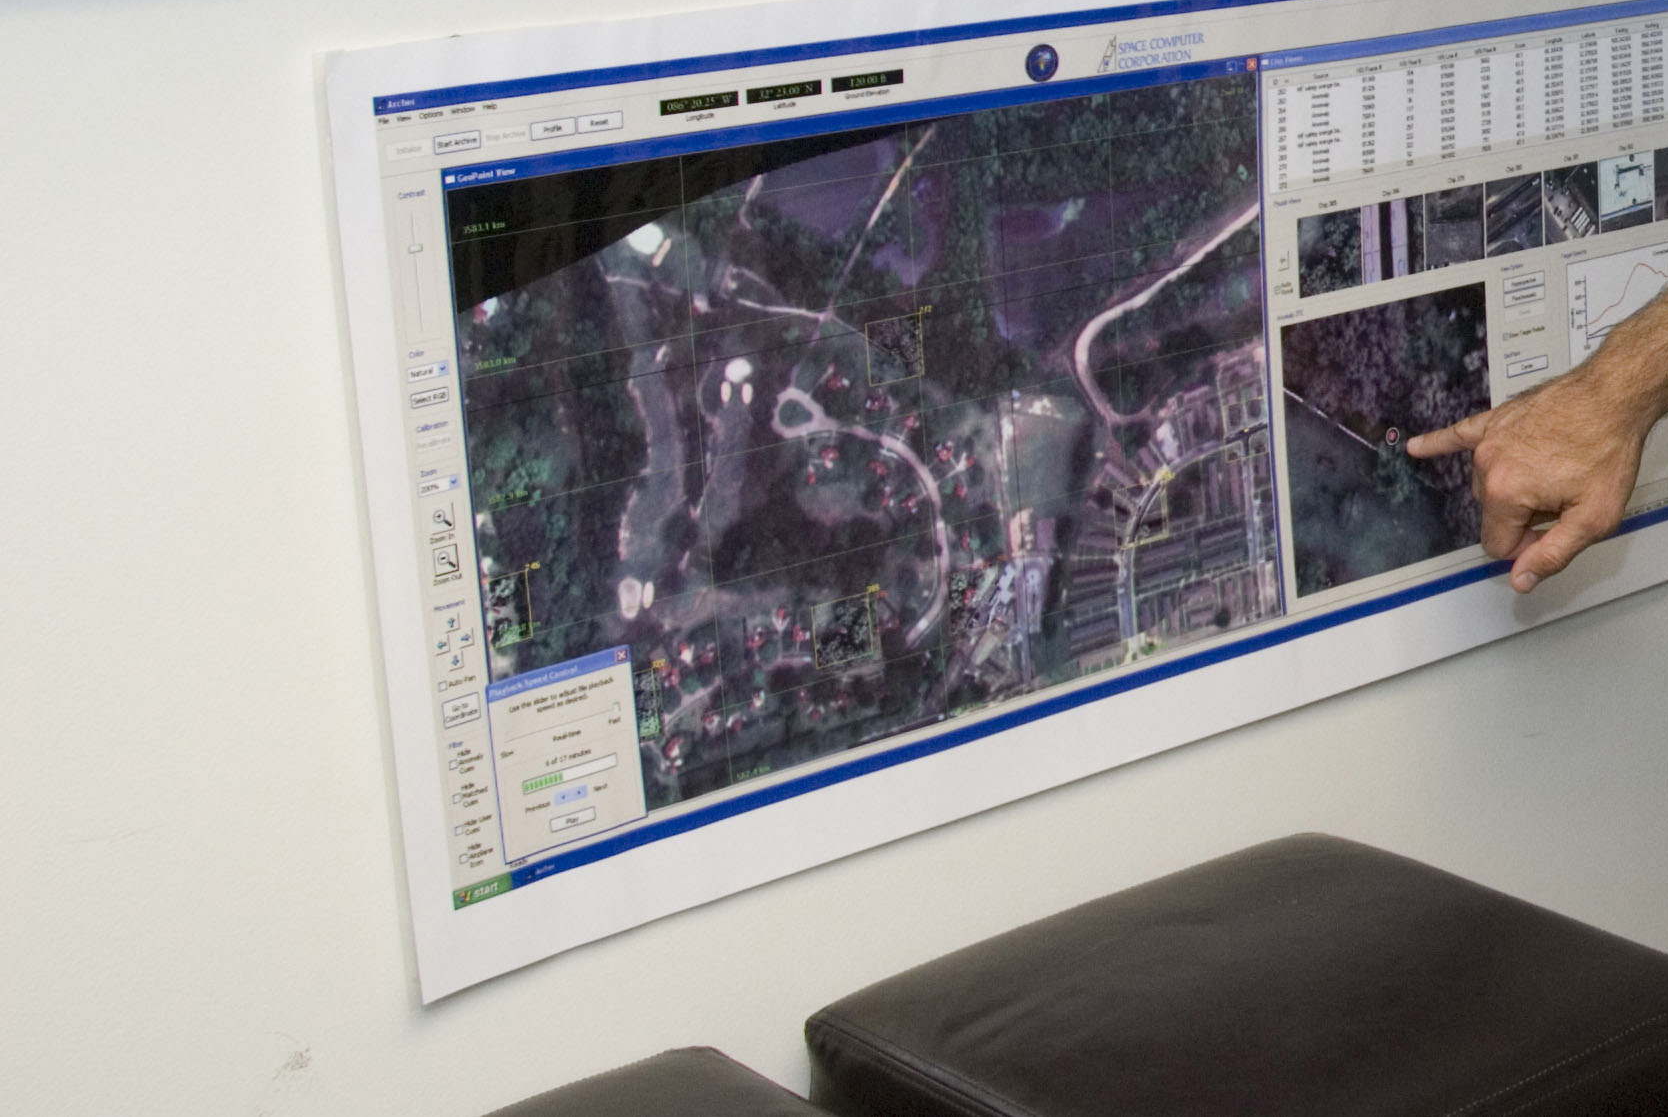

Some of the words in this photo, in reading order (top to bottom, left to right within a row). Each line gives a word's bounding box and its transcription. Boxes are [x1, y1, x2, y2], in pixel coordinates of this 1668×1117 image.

[1118, 39, 1147, 55] SPACE
[1149, 32, 1205, 51] COMPUTER
[1118, 49, 1193, 70] CORPORATION
[419, 110, 444, 121] Options
[473, 882, 499, 898] start
